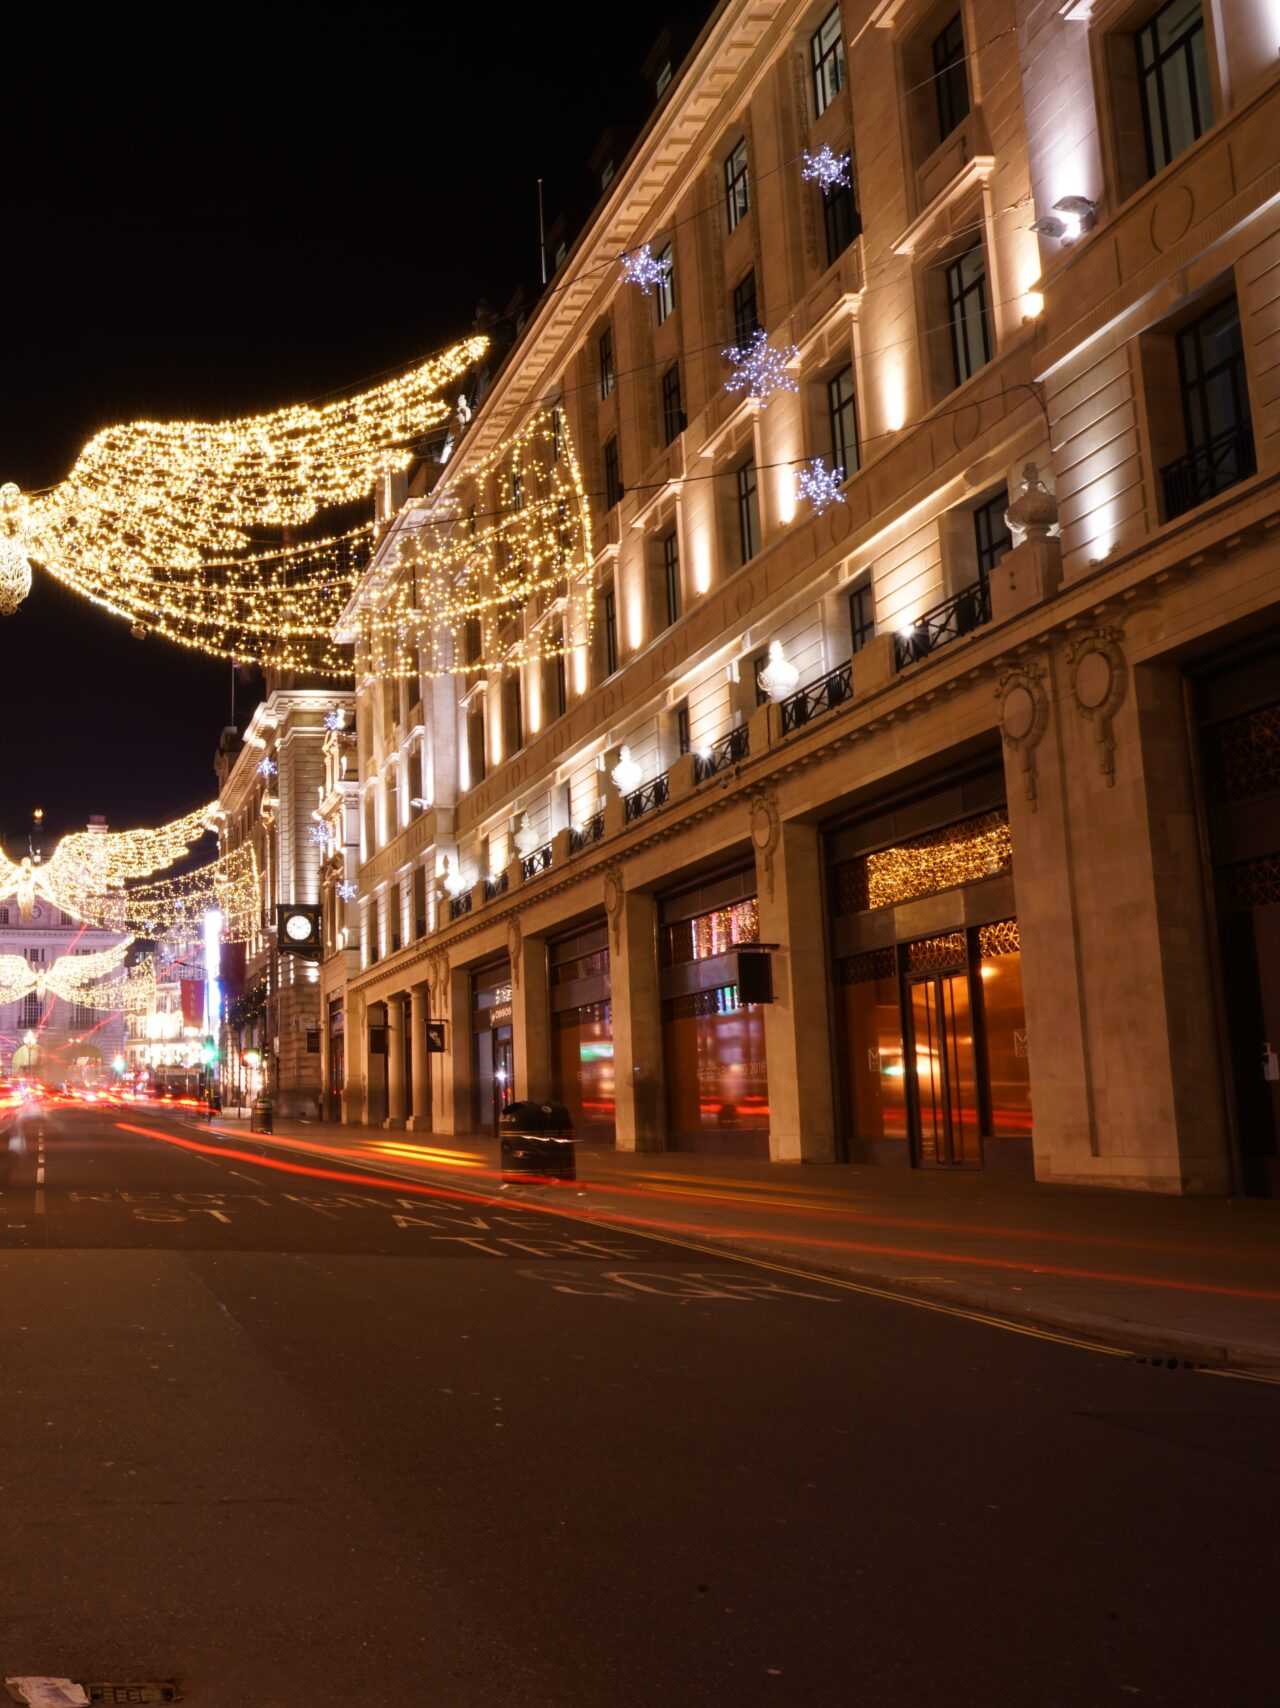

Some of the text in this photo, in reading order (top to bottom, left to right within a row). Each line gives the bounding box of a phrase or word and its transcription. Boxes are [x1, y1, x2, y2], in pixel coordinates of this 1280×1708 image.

[133, 1208, 239, 1223] ST
[391, 1214, 552, 1231] AVE
[515, 1268, 843, 1303] SQR
